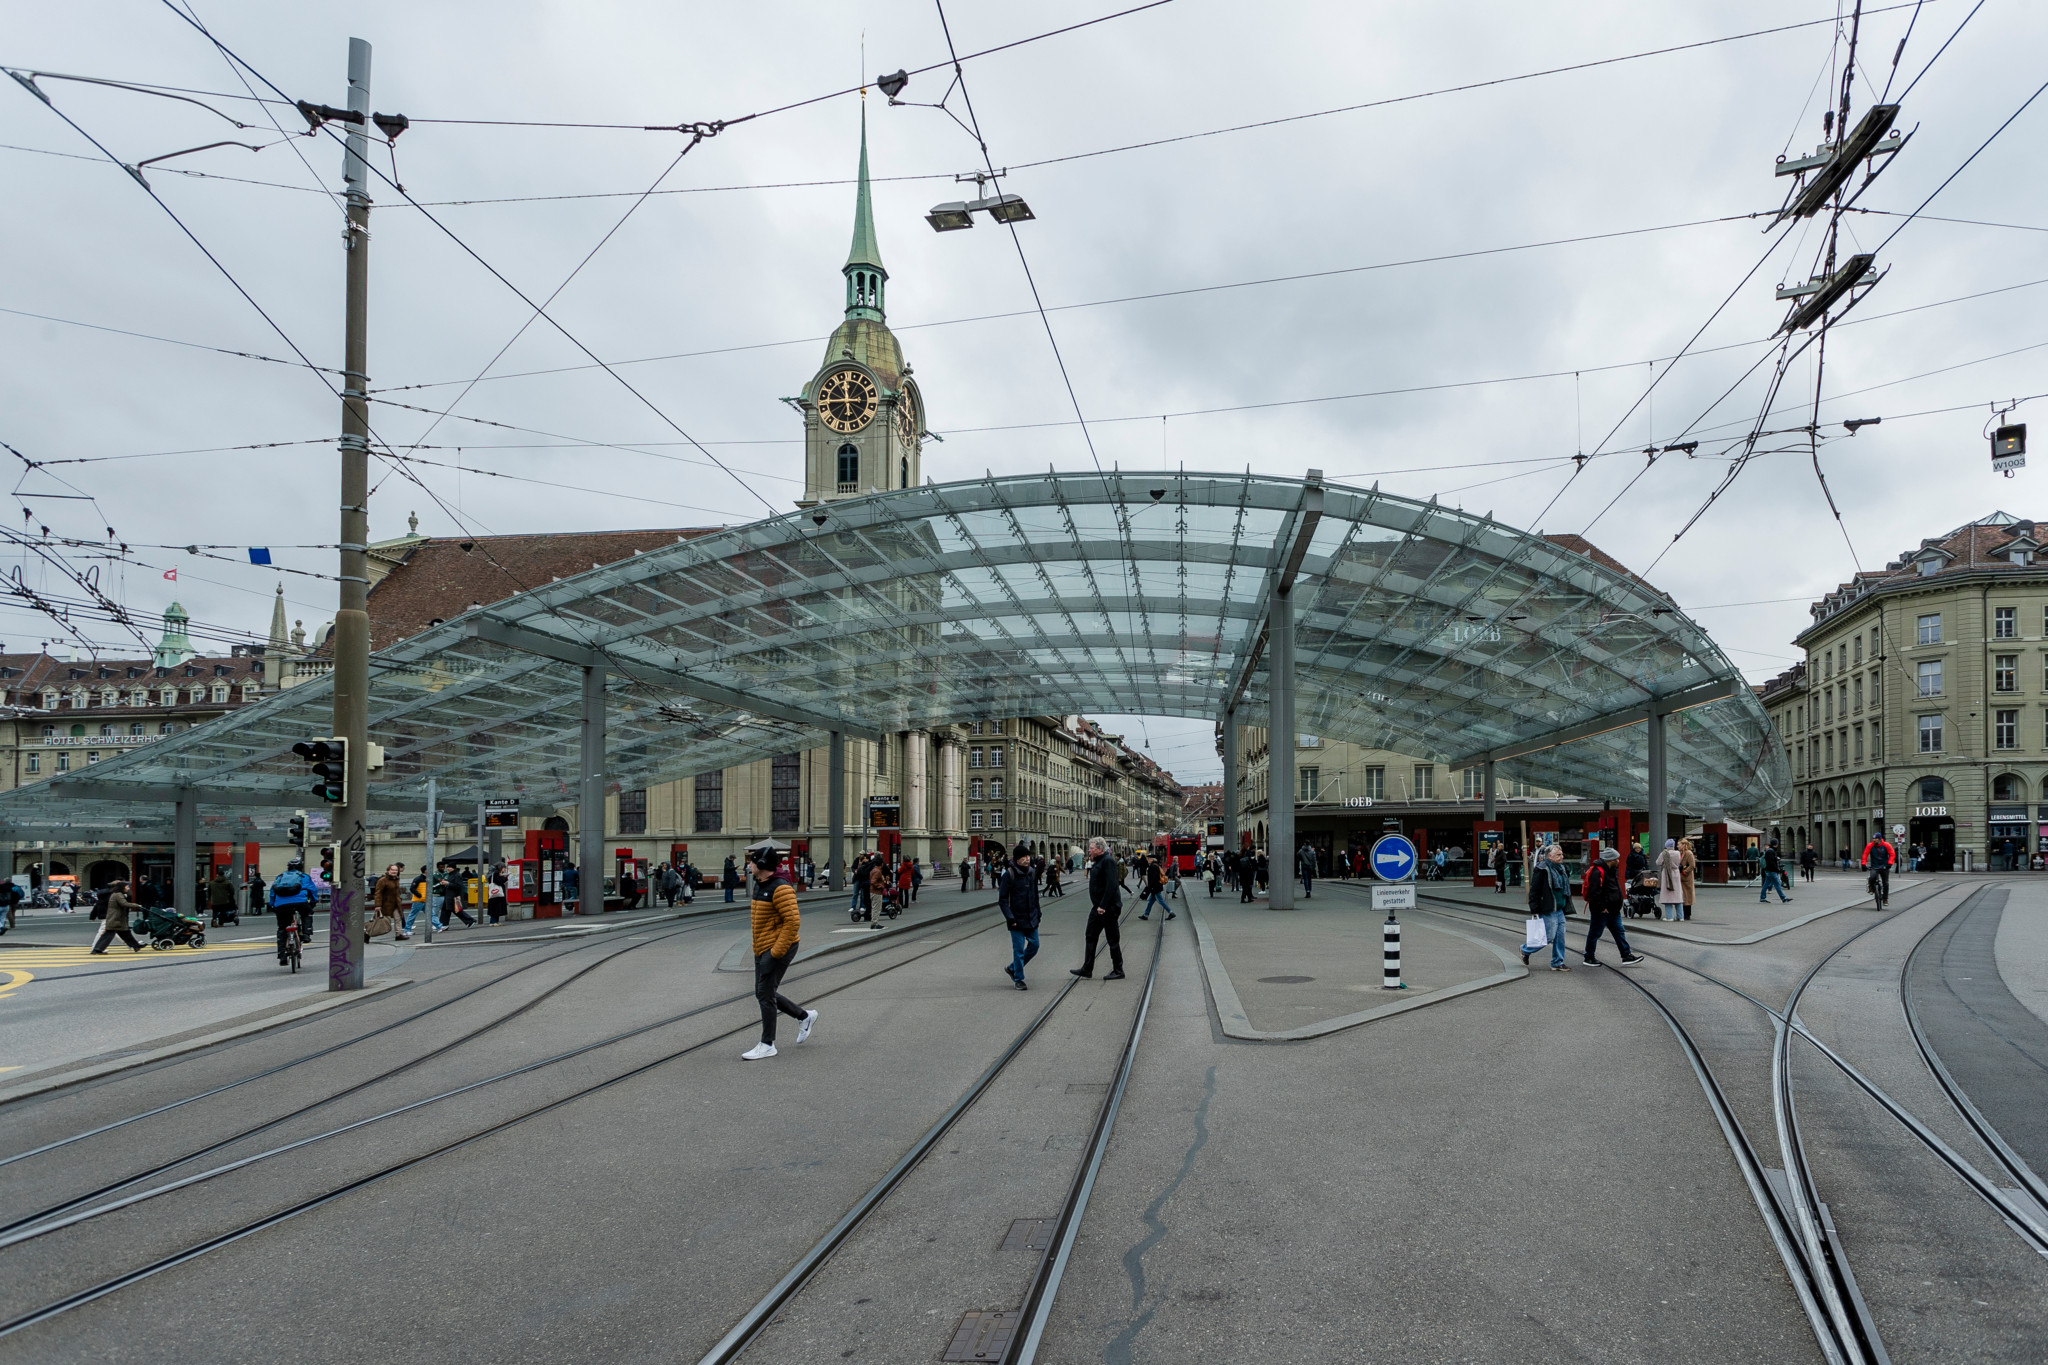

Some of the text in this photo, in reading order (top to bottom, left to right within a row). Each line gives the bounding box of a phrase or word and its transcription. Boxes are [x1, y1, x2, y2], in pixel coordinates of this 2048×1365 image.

[1993, 458, 2026, 470] W1003
[44, 736, 80, 746] HOTEL
[1345, 796, 1373, 807] LOEB
[1915, 806, 1947, 817] LOEB
[1376, 888, 1411, 896] Linienverkehr
[1382, 897, 1406, 906] gestattet
